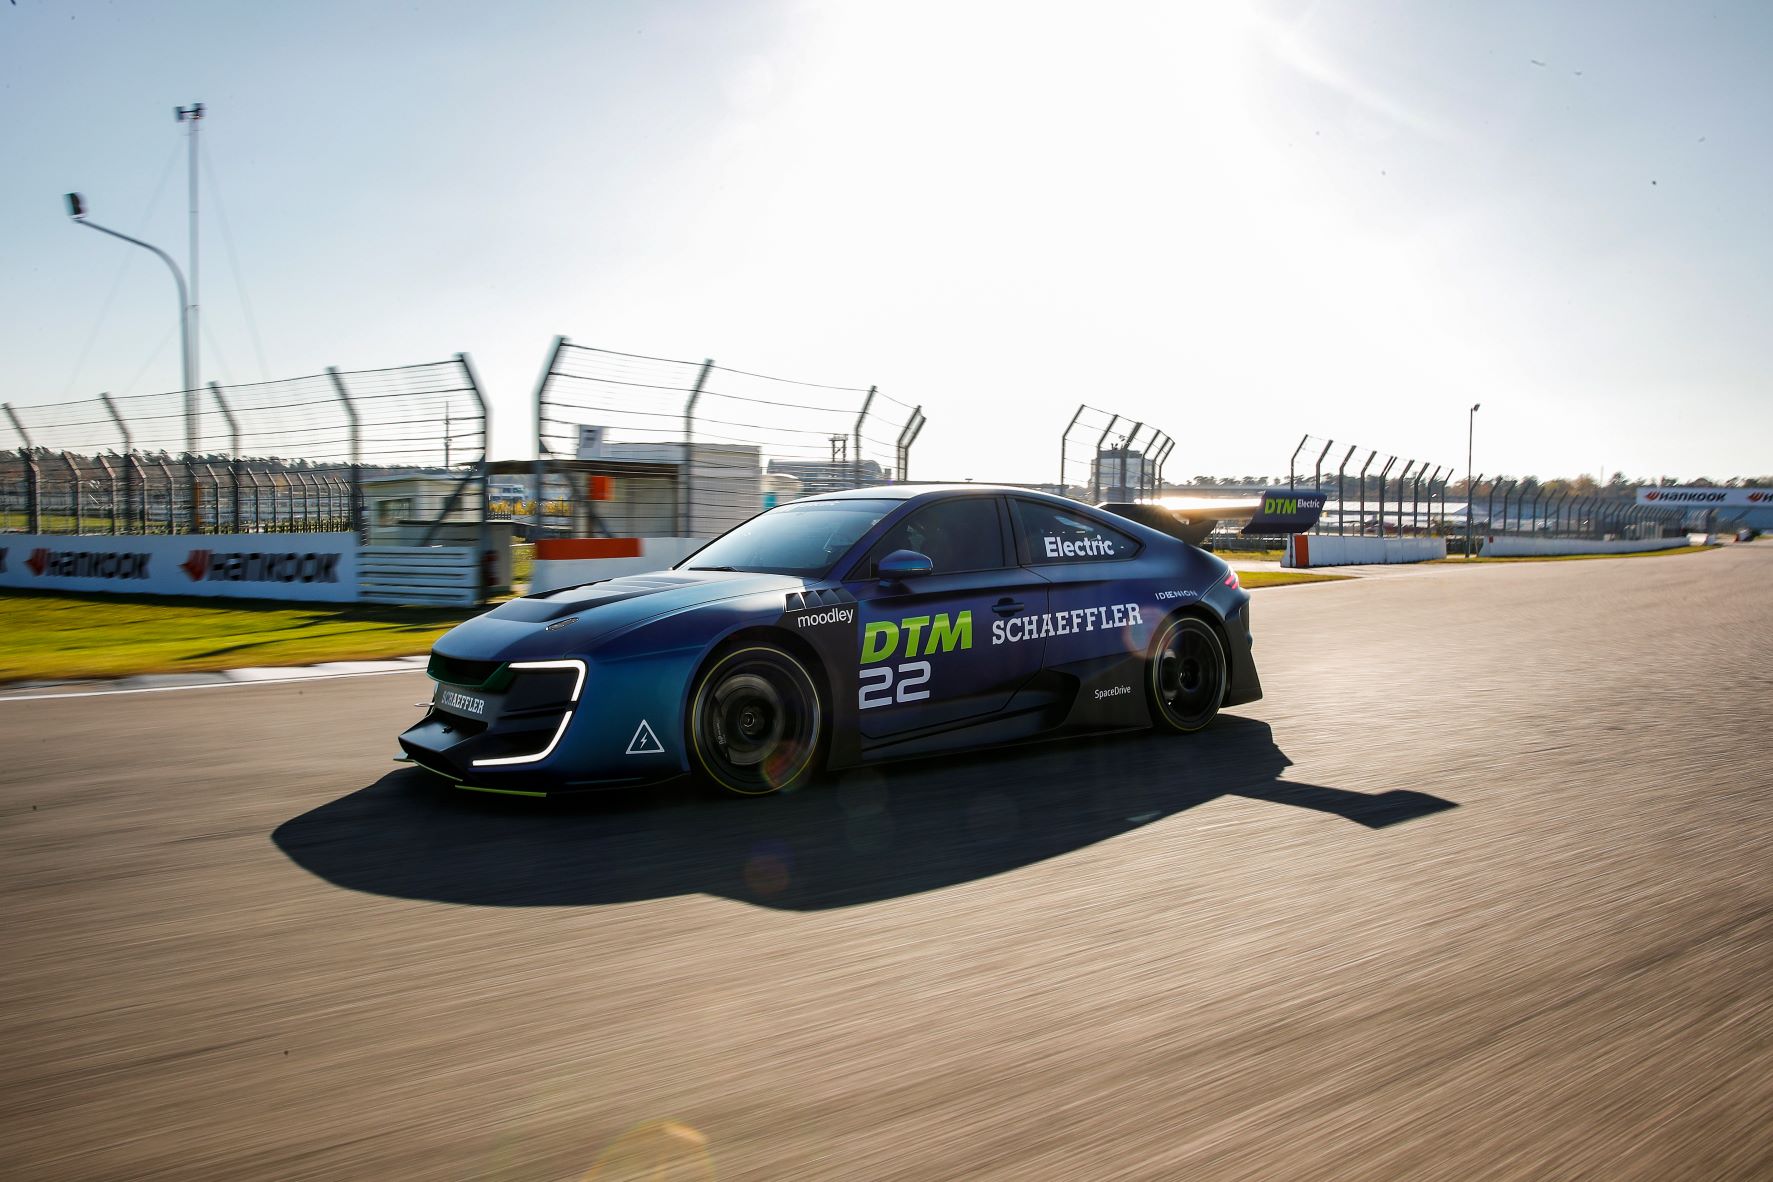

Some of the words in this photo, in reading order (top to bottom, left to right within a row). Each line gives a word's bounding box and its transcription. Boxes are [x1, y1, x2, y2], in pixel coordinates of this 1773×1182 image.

[1264, 498, 1297, 514] DTM
[1297, 498, 1320, 509] Electric
[1043, 534, 1115, 557] Electric
[797, 607, 854, 628] moodley
[992, 602, 1143, 645] SCHAEFFLER
[860, 610, 972, 665] DTM
[858, 660, 931, 710] 22
[1094, 684, 1131, 700] SpaceDrive
[441, 690, 485, 715] SCHAEFFLER
